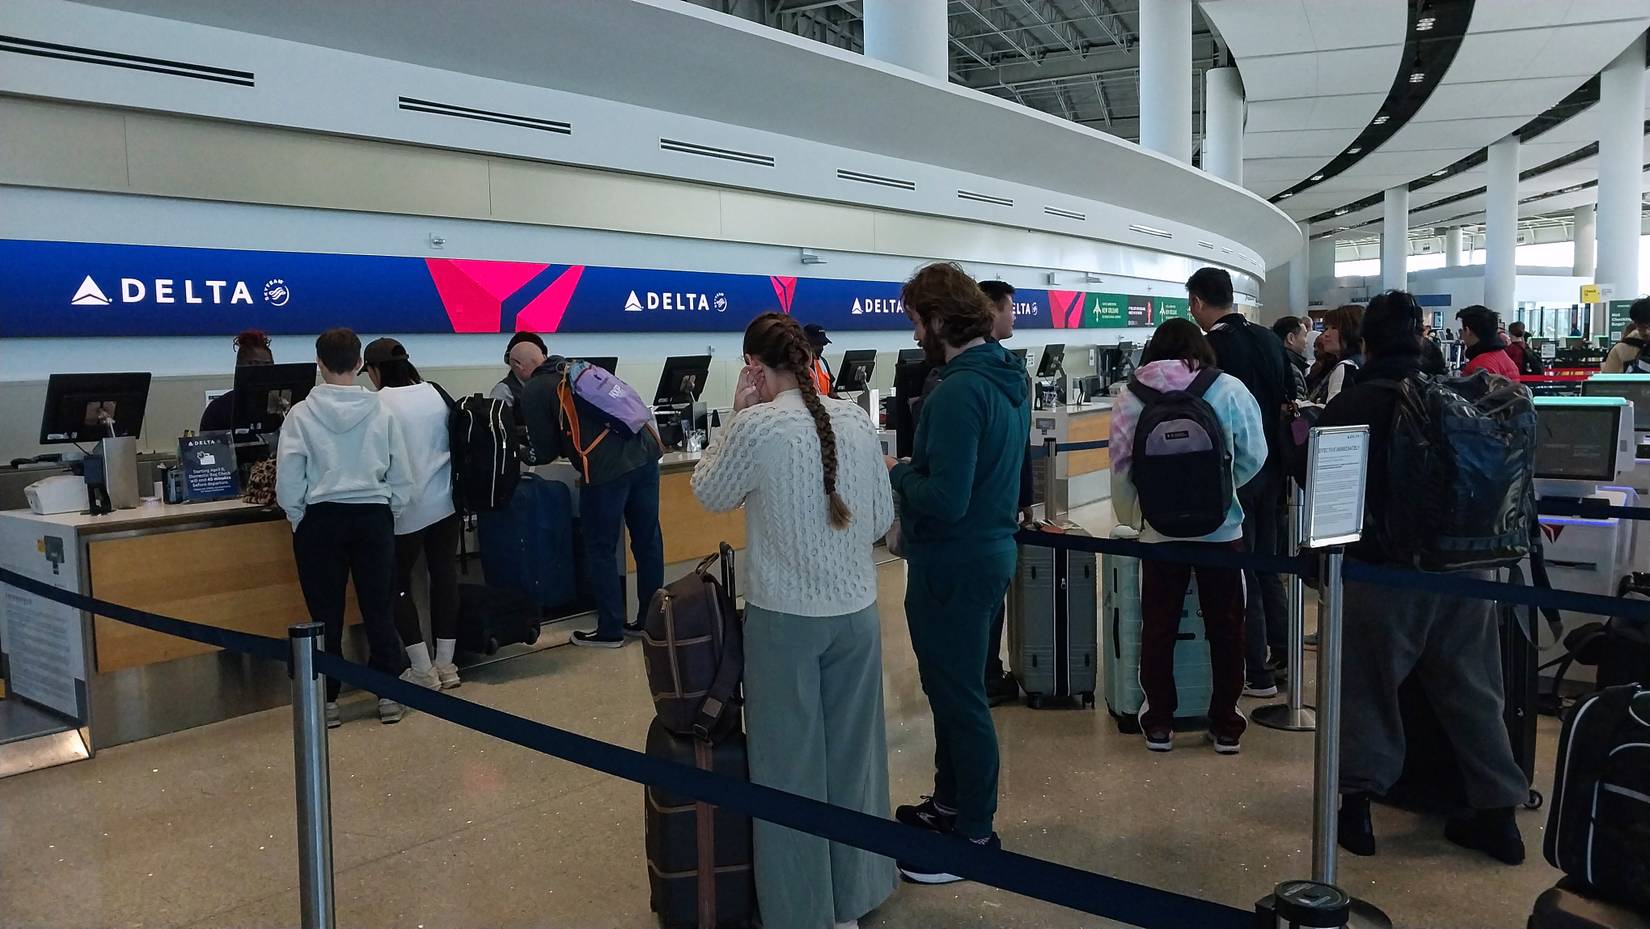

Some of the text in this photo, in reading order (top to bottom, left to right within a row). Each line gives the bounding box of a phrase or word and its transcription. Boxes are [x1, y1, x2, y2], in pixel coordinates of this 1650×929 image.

[121, 278, 254, 305] DELTA
[647, 292, 710, 311] DELTA
[865, 298, 904, 314] DELTA
[1012, 302, 1031, 315] ELTA
